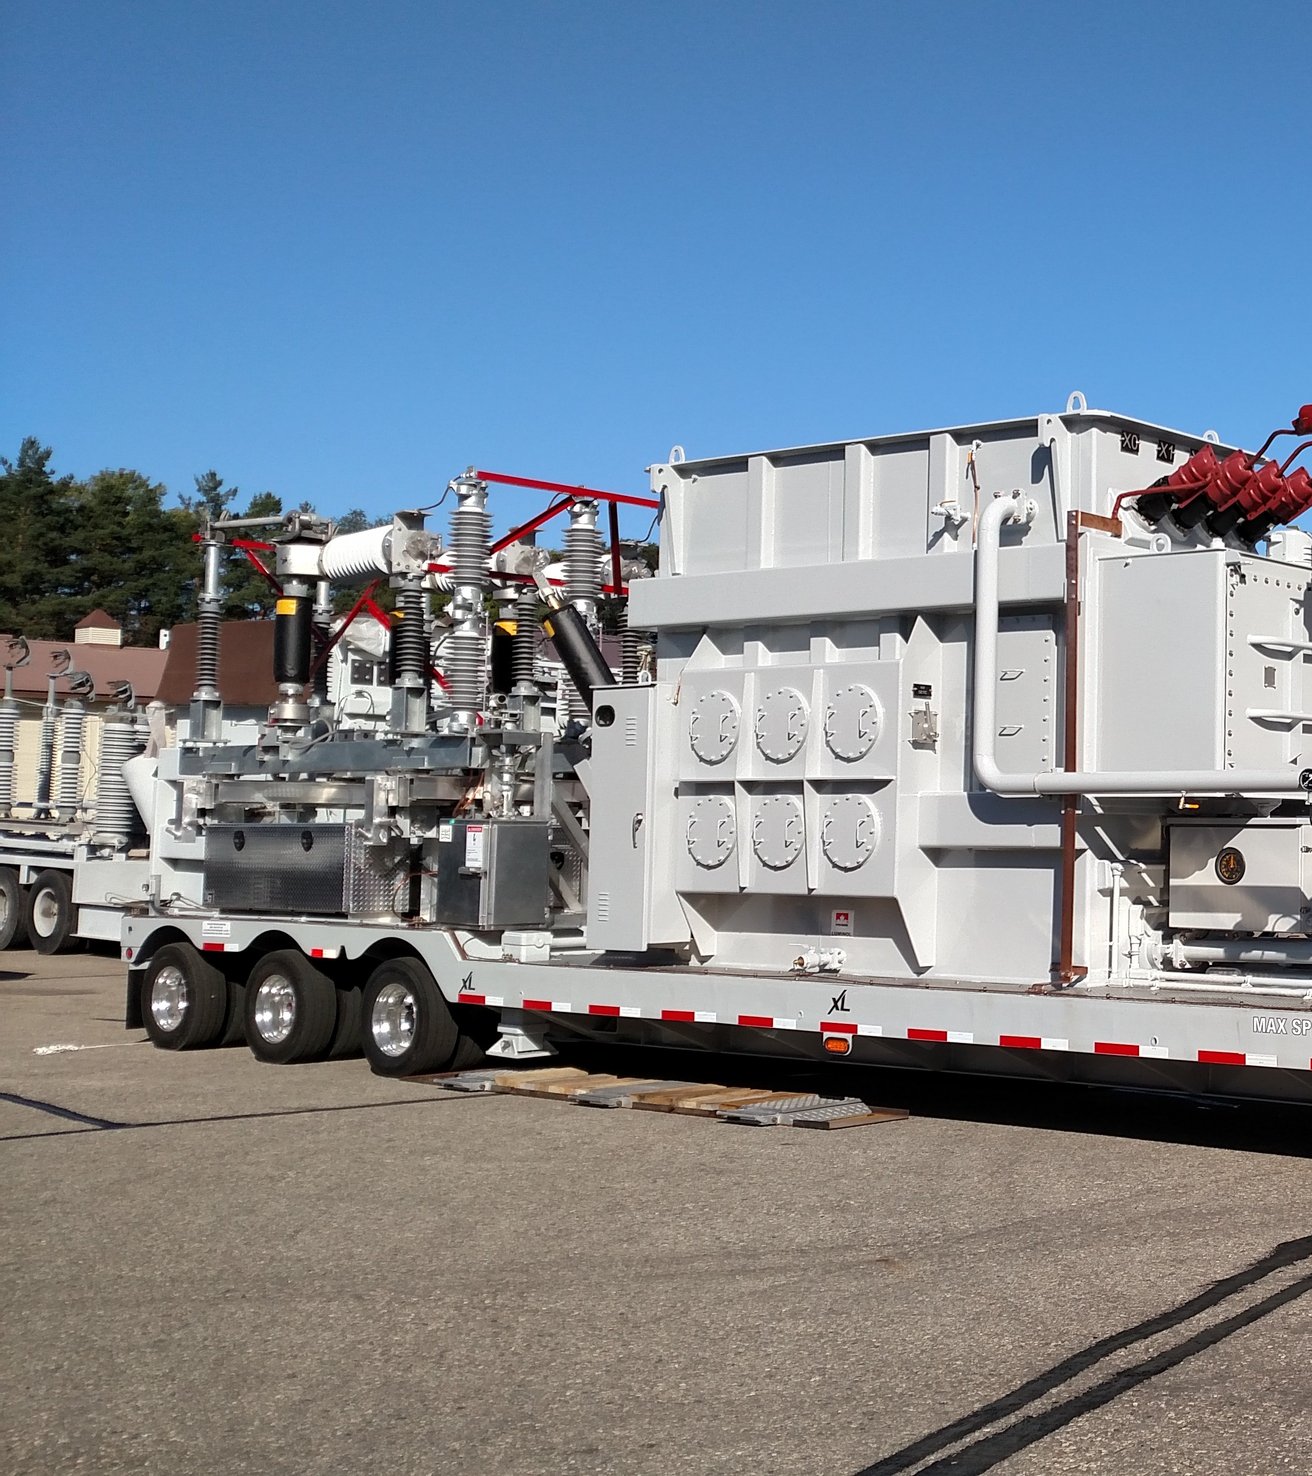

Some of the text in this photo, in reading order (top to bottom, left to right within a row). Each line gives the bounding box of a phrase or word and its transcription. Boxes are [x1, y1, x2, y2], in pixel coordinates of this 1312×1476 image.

[1159, 442, 1174, 460] X1
[458, 971, 476, 993] XL
[827, 989, 851, 1015] XL
[1252, 1016, 1287, 1034] MAX
